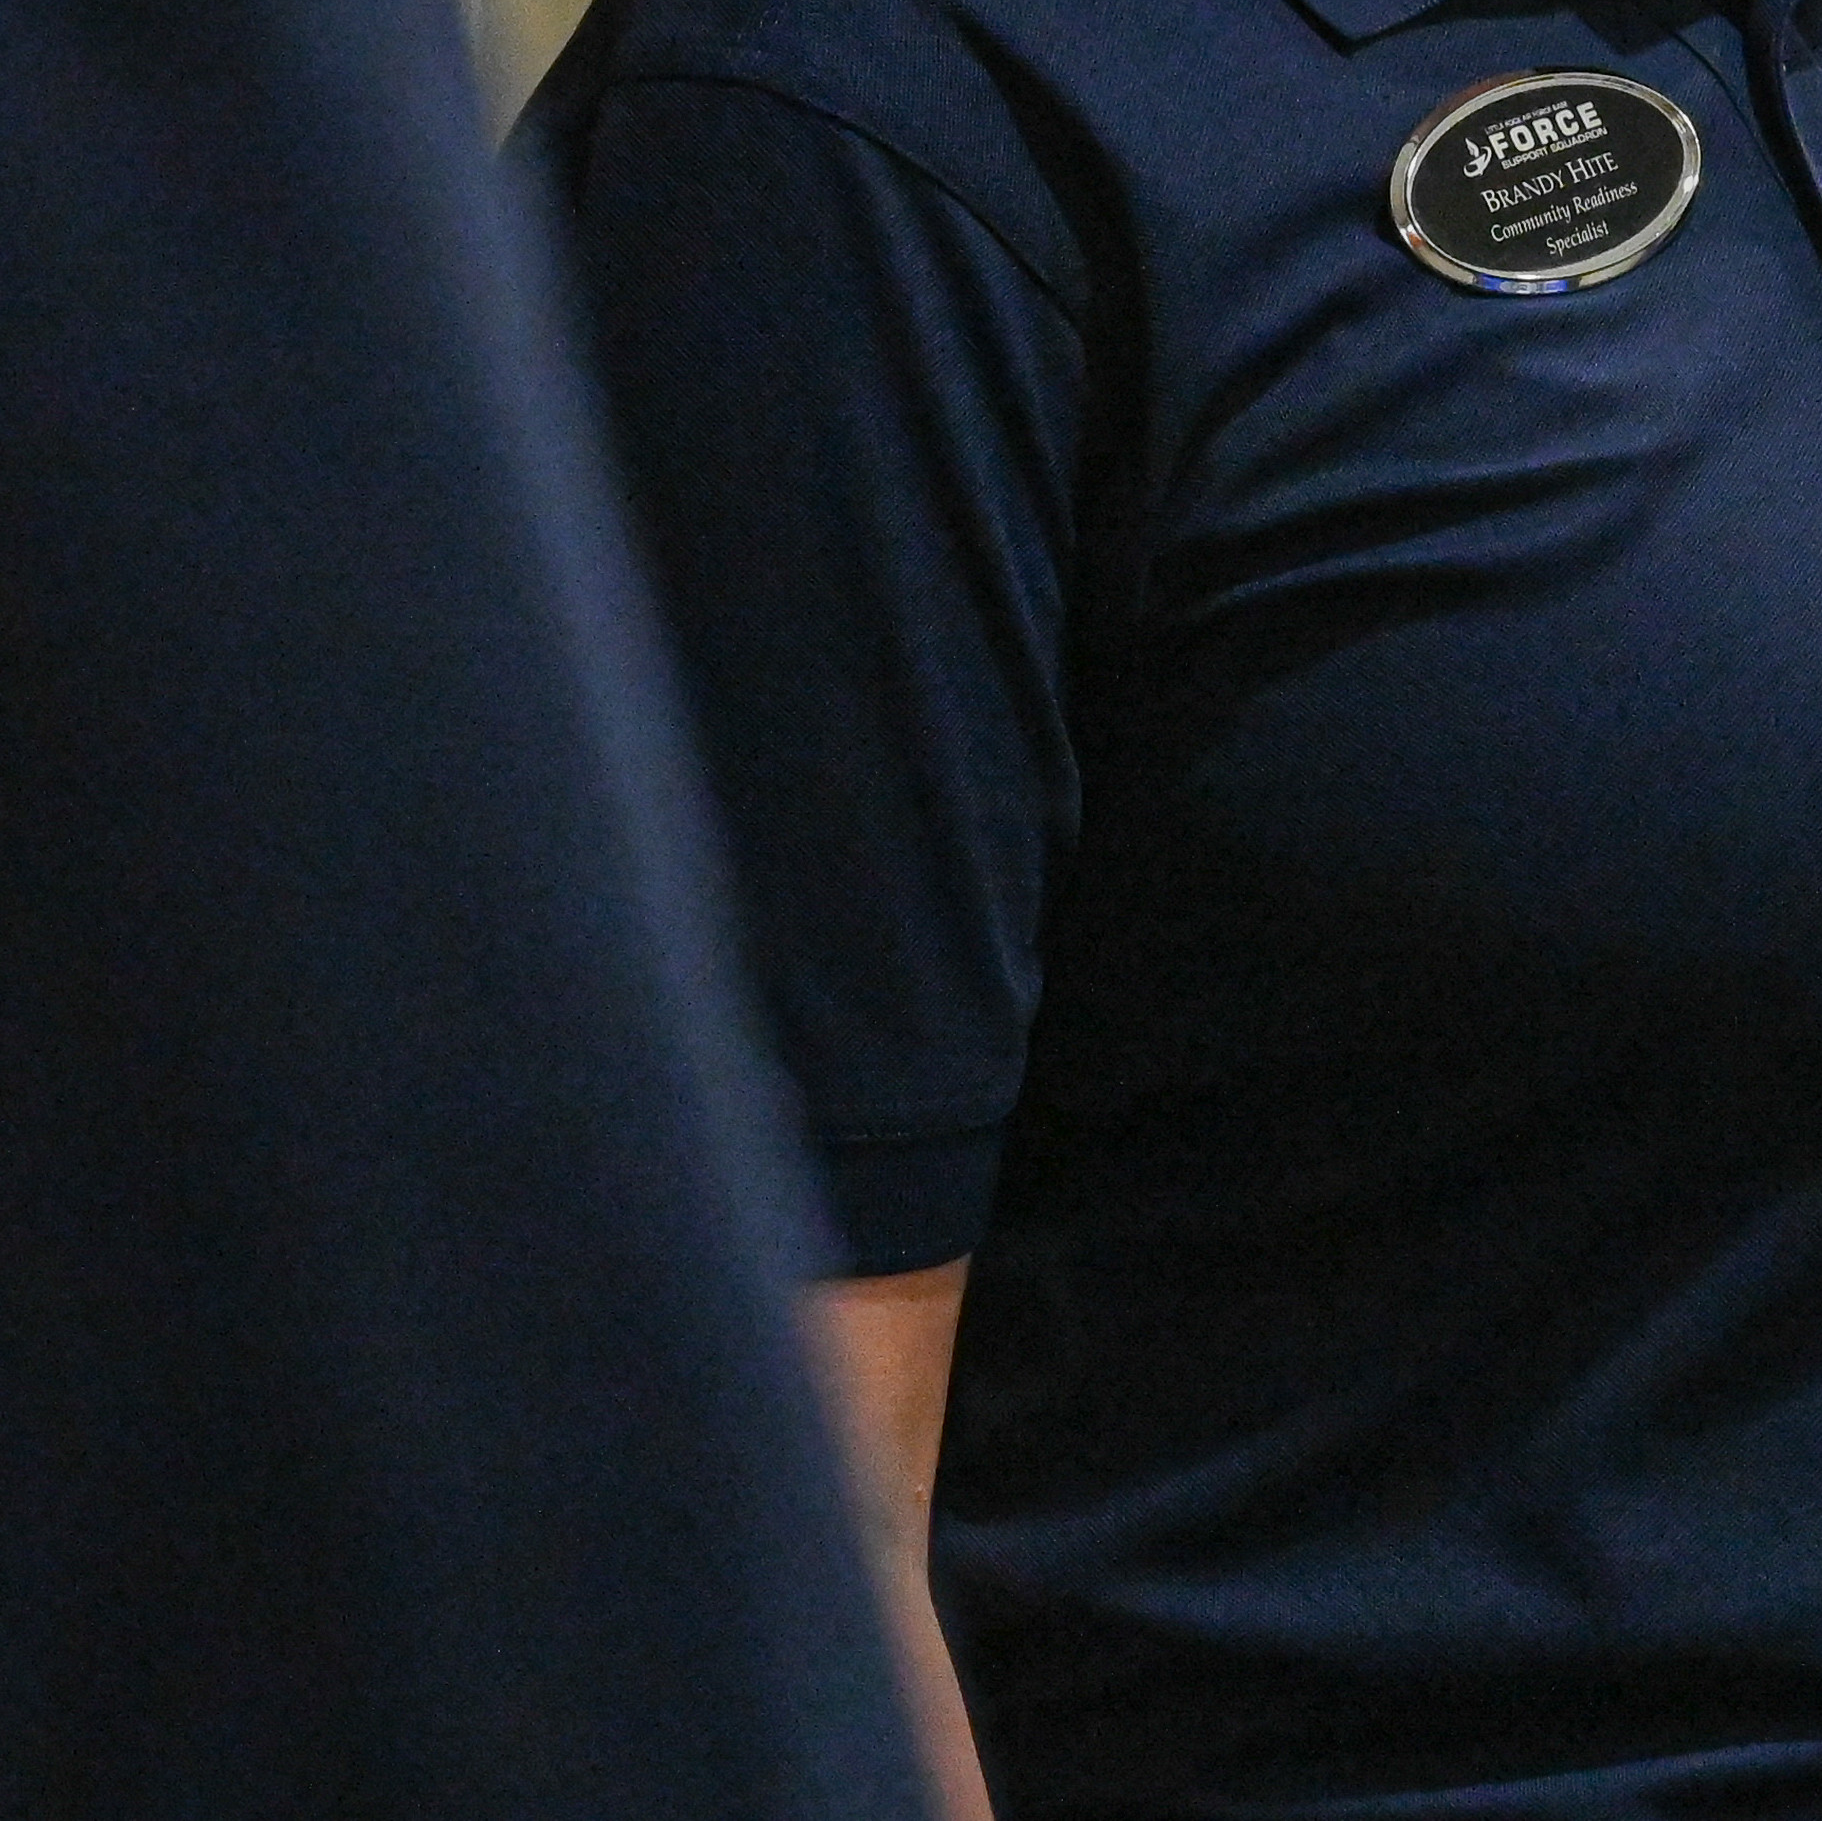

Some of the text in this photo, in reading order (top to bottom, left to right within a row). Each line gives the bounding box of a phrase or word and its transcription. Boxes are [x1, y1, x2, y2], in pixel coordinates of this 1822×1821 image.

[1488, 101, 1603, 160] FORCE
[1501, 126, 1608, 170] SUPPORT SQUADRON
[1480, 152, 1619, 213] BRANDY HITE
[1490, 181, 1638, 243] Community Readiness
[1546, 219, 1609, 257] Specialist
